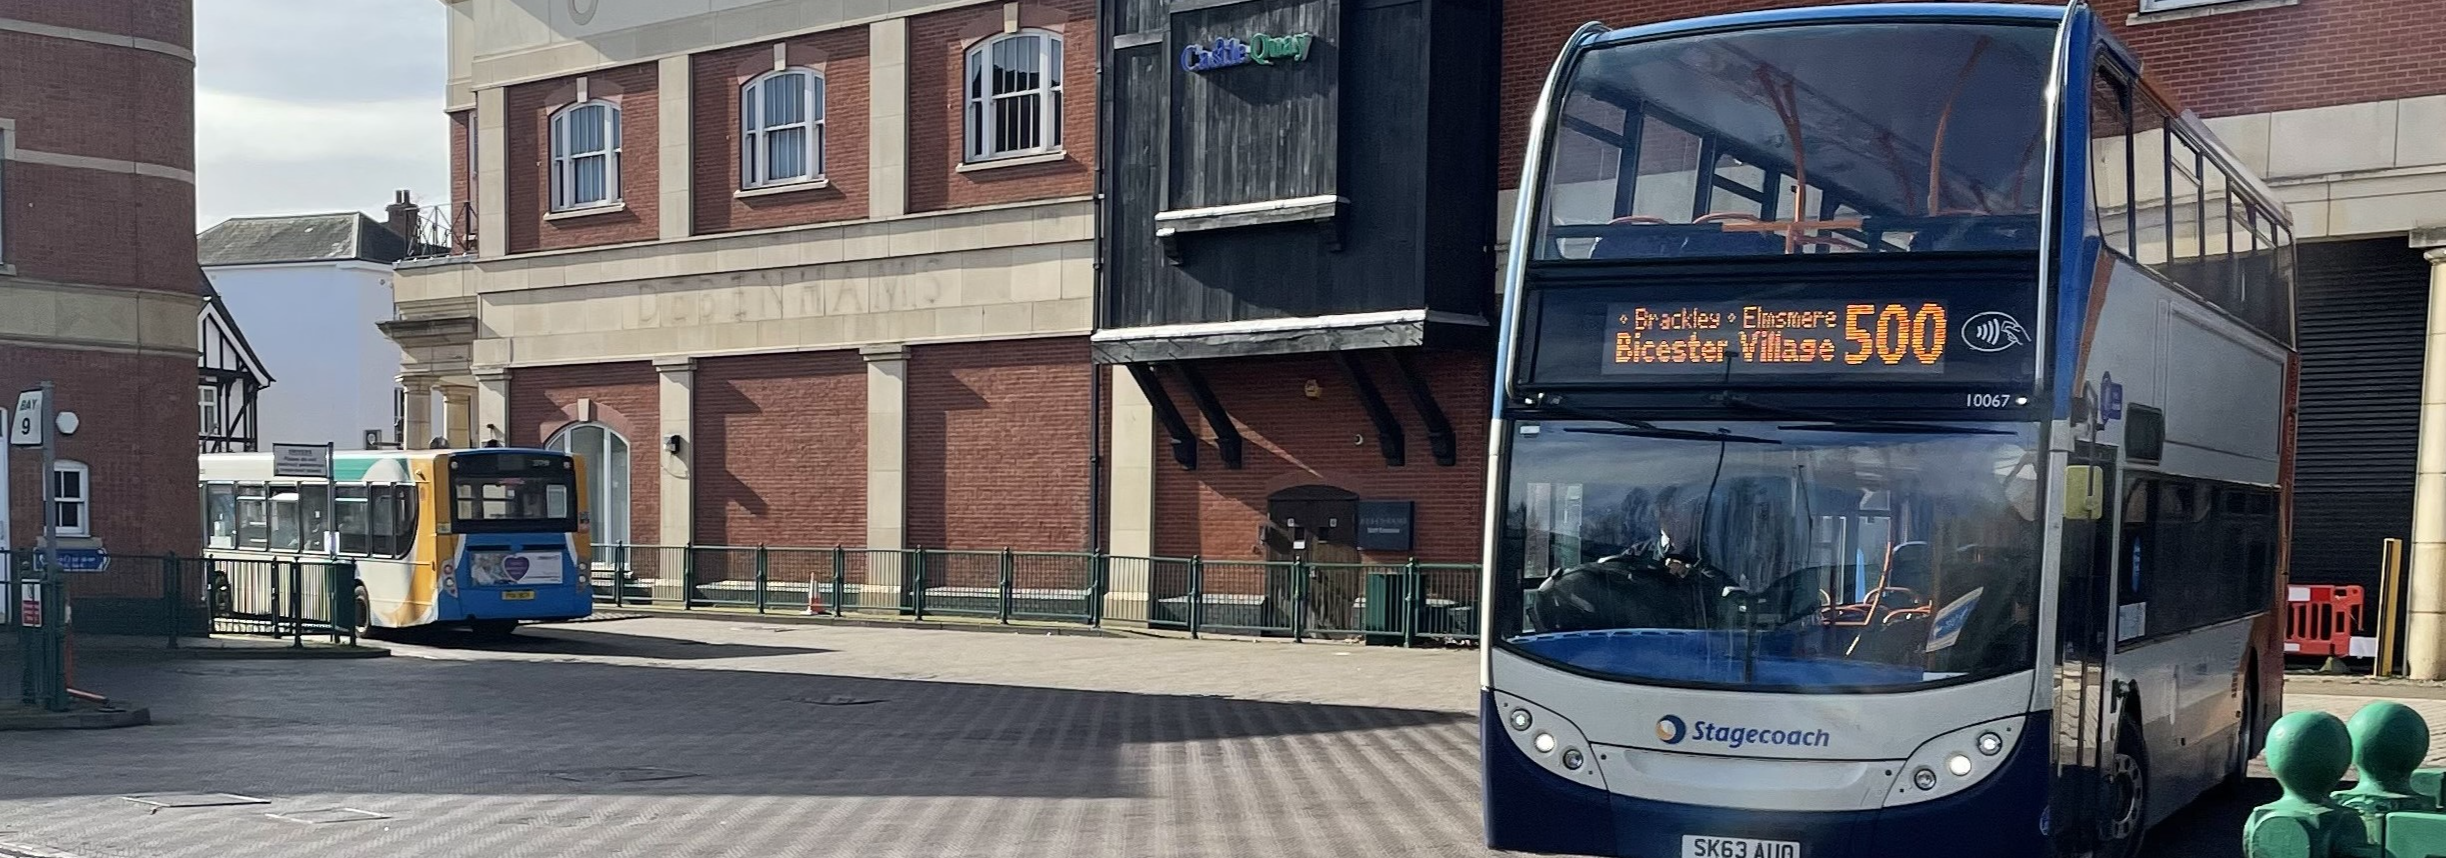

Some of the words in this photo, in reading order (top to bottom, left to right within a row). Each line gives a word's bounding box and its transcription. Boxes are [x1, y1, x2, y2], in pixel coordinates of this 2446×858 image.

[1634, 307, 1721, 330] Brackley
[1743, 306, 1838, 329] Elmsmere
[1844, 303, 1948, 365] 500
[1615, 332, 1728, 363] Bicester
[1738, 331, 1835, 363] Village
[19, 399, 38, 411] BAY
[1966, 393, 2011, 407] 10067
[21, 417, 31, 435] 9
[1692, 721, 1830, 748] Stagecoach
[1694, 838, 1747, 858] SK63
